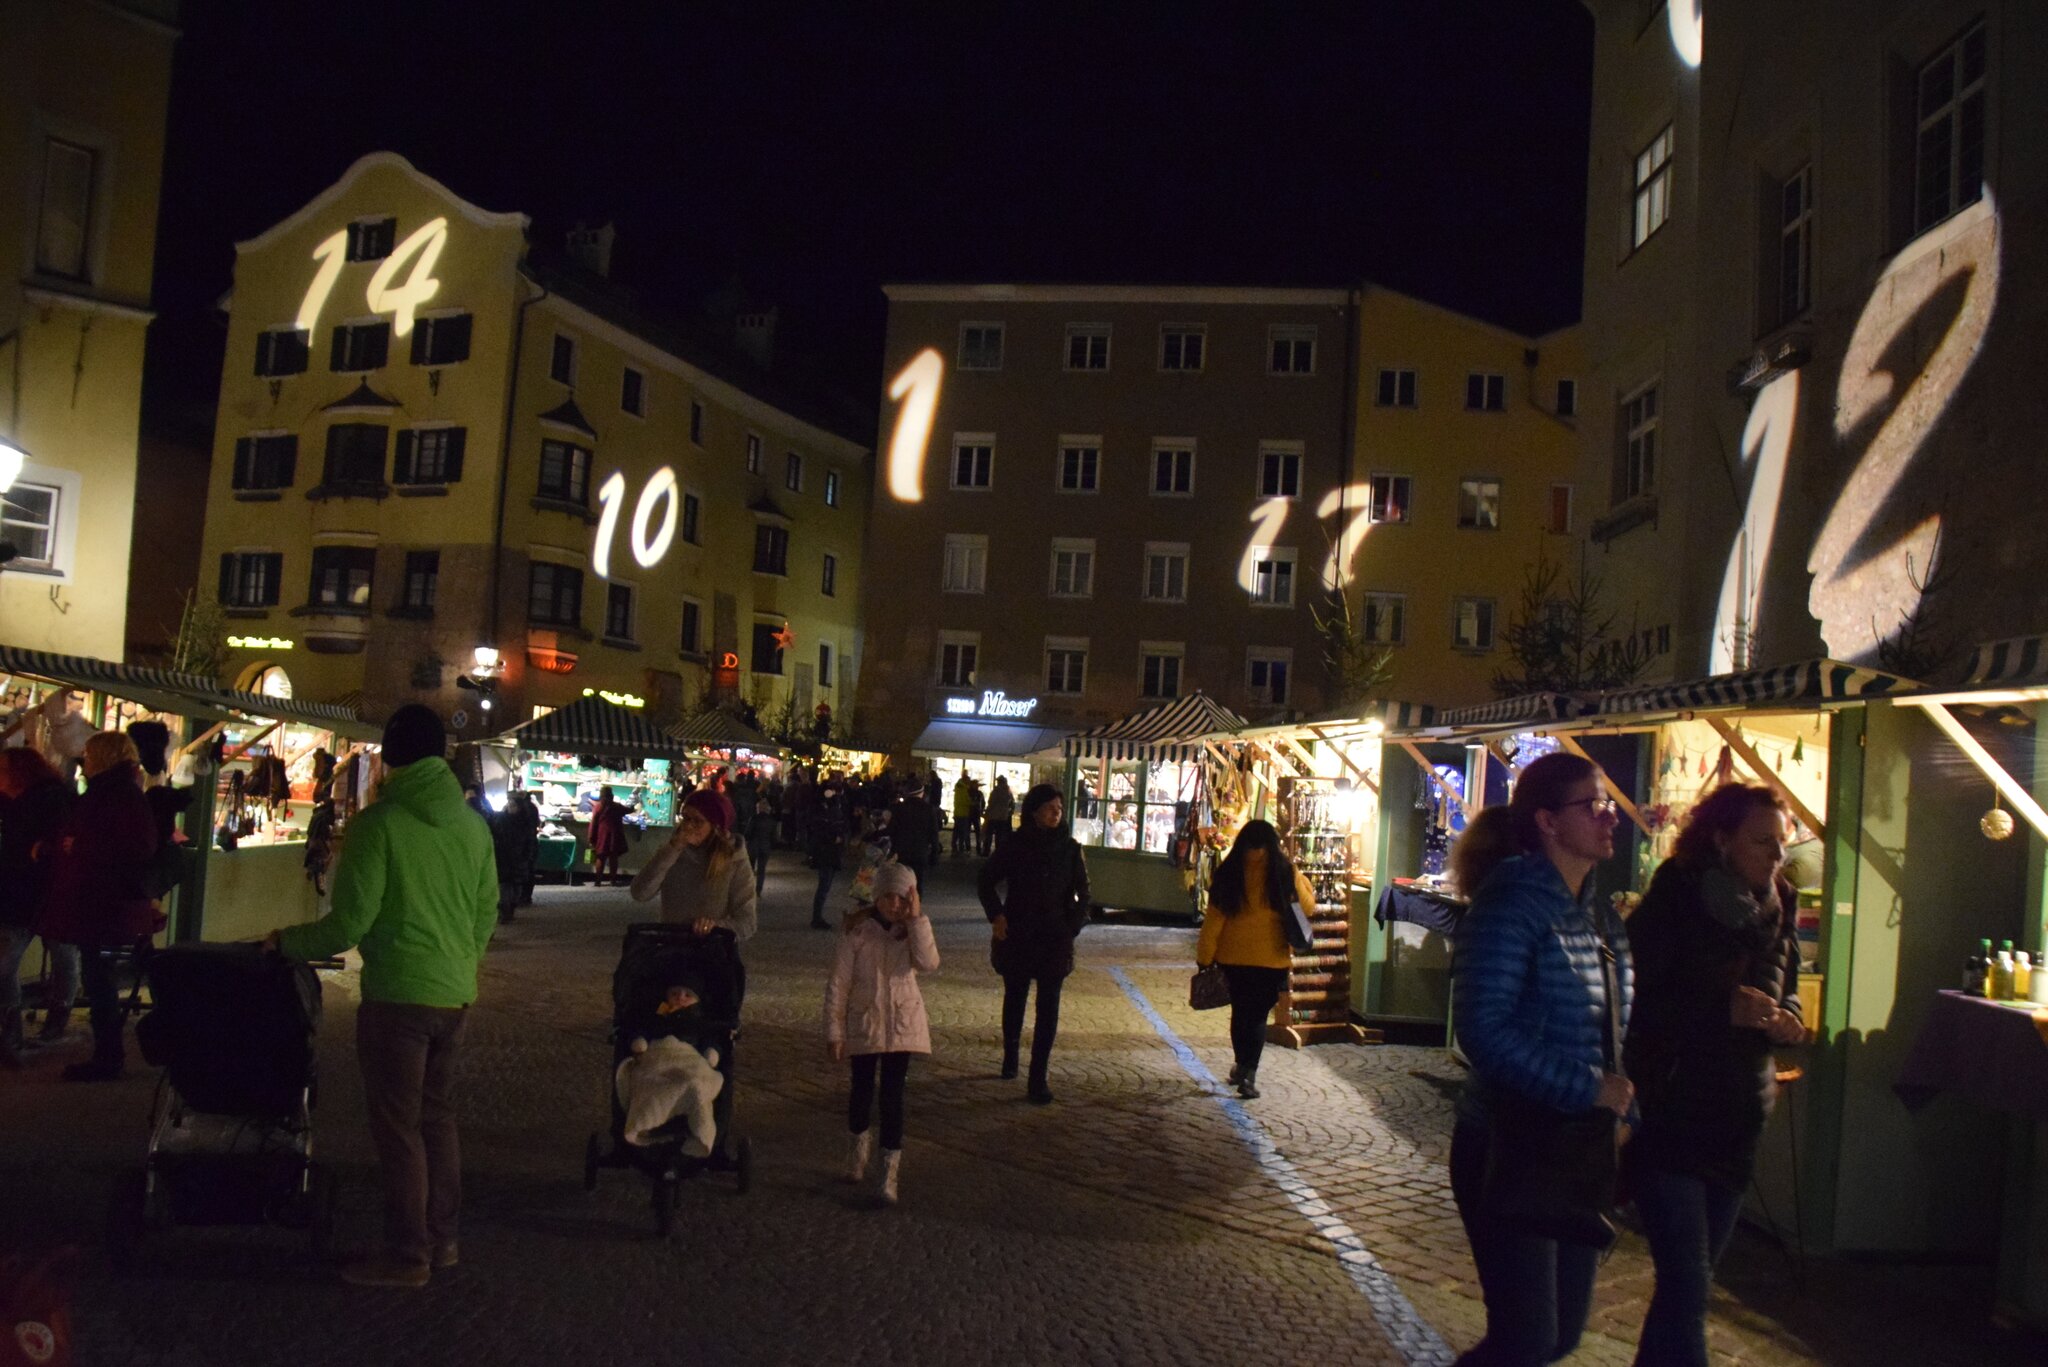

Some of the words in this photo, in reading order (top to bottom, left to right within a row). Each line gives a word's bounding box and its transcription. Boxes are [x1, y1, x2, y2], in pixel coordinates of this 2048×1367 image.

[296, 217, 448, 347] 14
[886, 347, 944, 503] 1
[1709, 178, 2002, 676] 12
[592, 465, 678, 580] 10
[977, 689, 1038, 718] Moser
